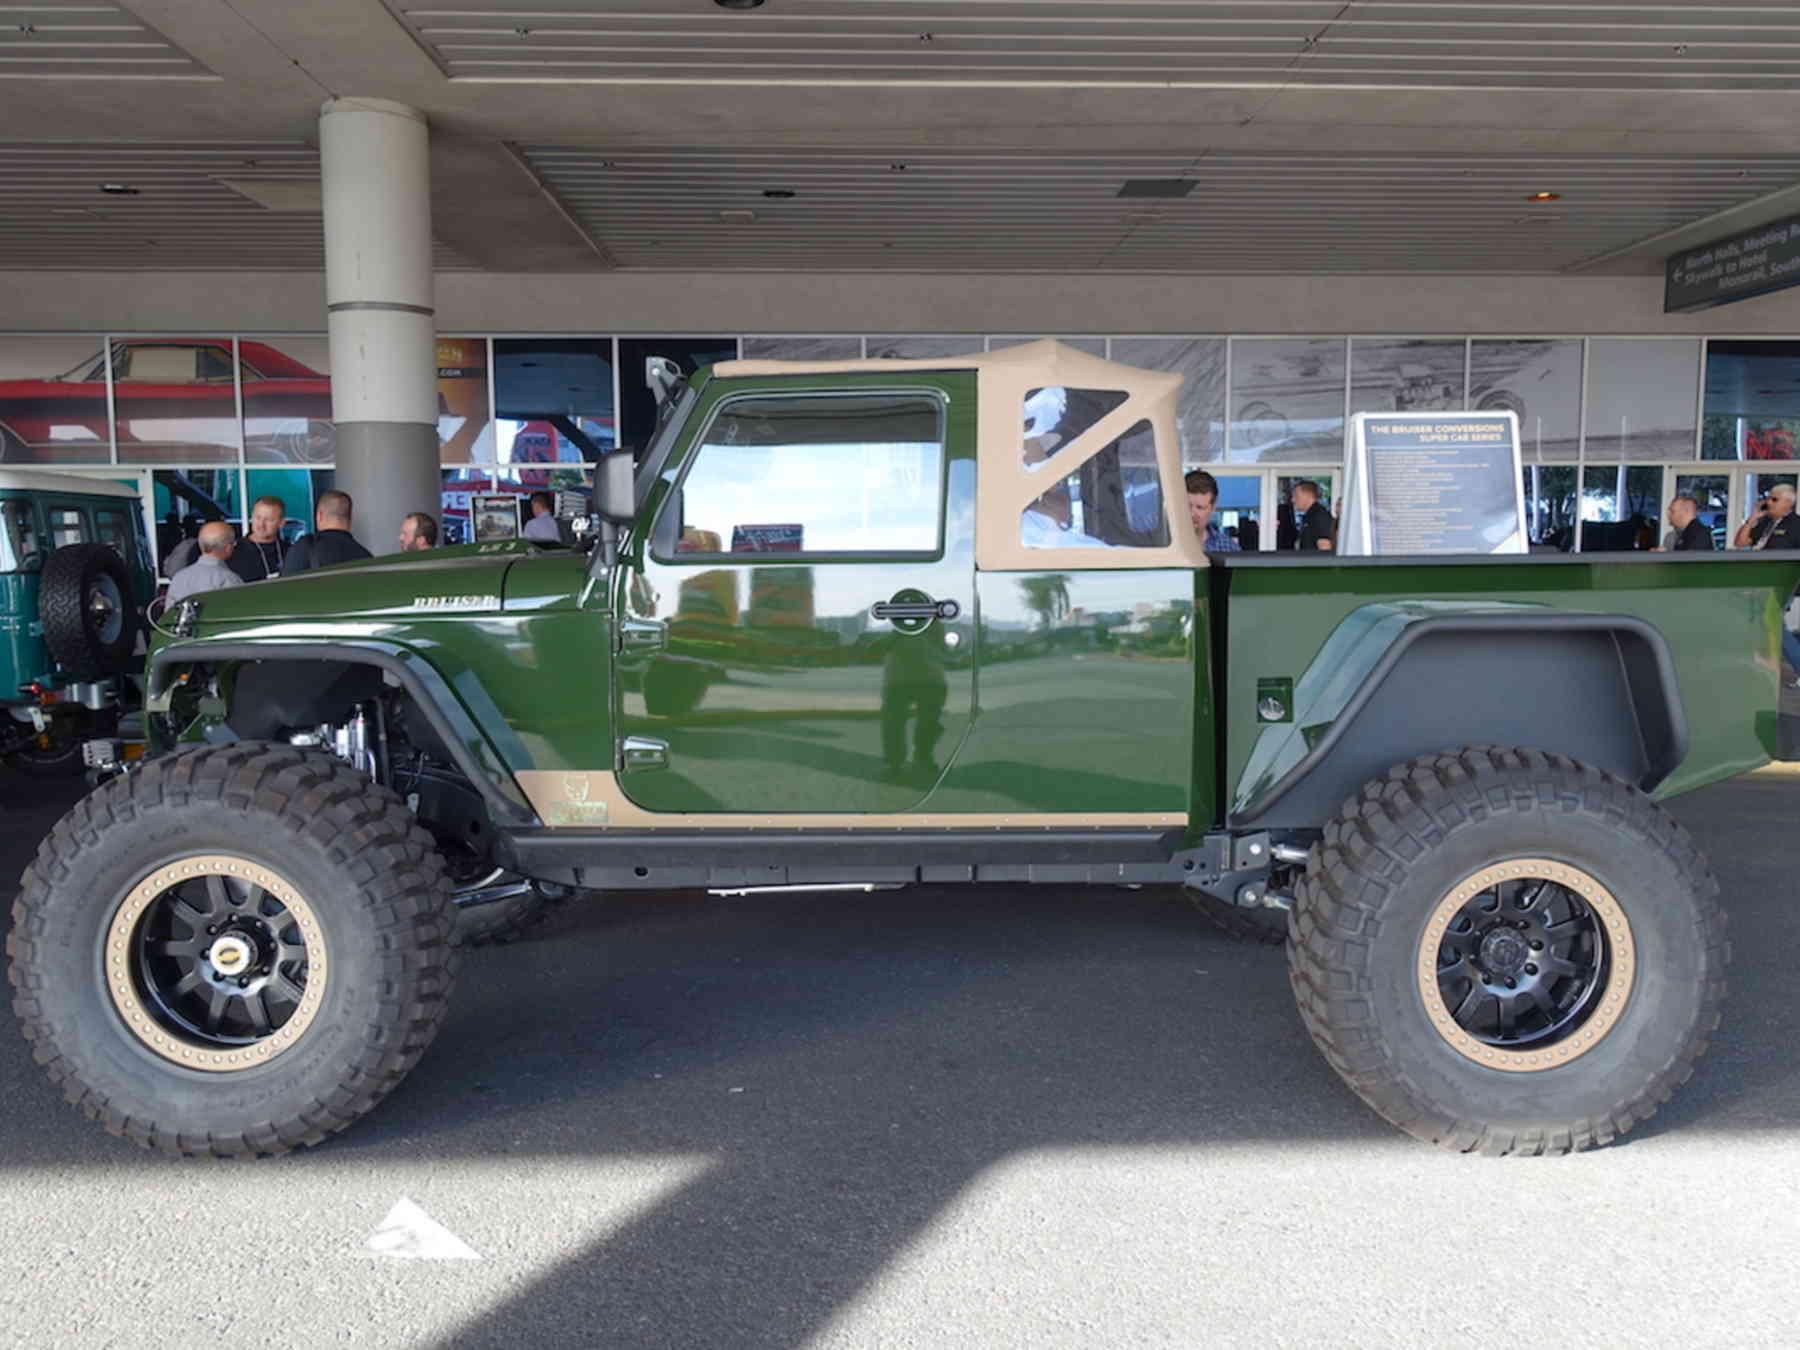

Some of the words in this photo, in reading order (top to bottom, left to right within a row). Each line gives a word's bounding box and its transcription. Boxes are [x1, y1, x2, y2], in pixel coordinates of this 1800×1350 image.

[1371, 424, 1390, 433] THE
[1435, 423, 1504, 433] CONVERSIONS
[1420, 433, 1449, 442] SUPER
